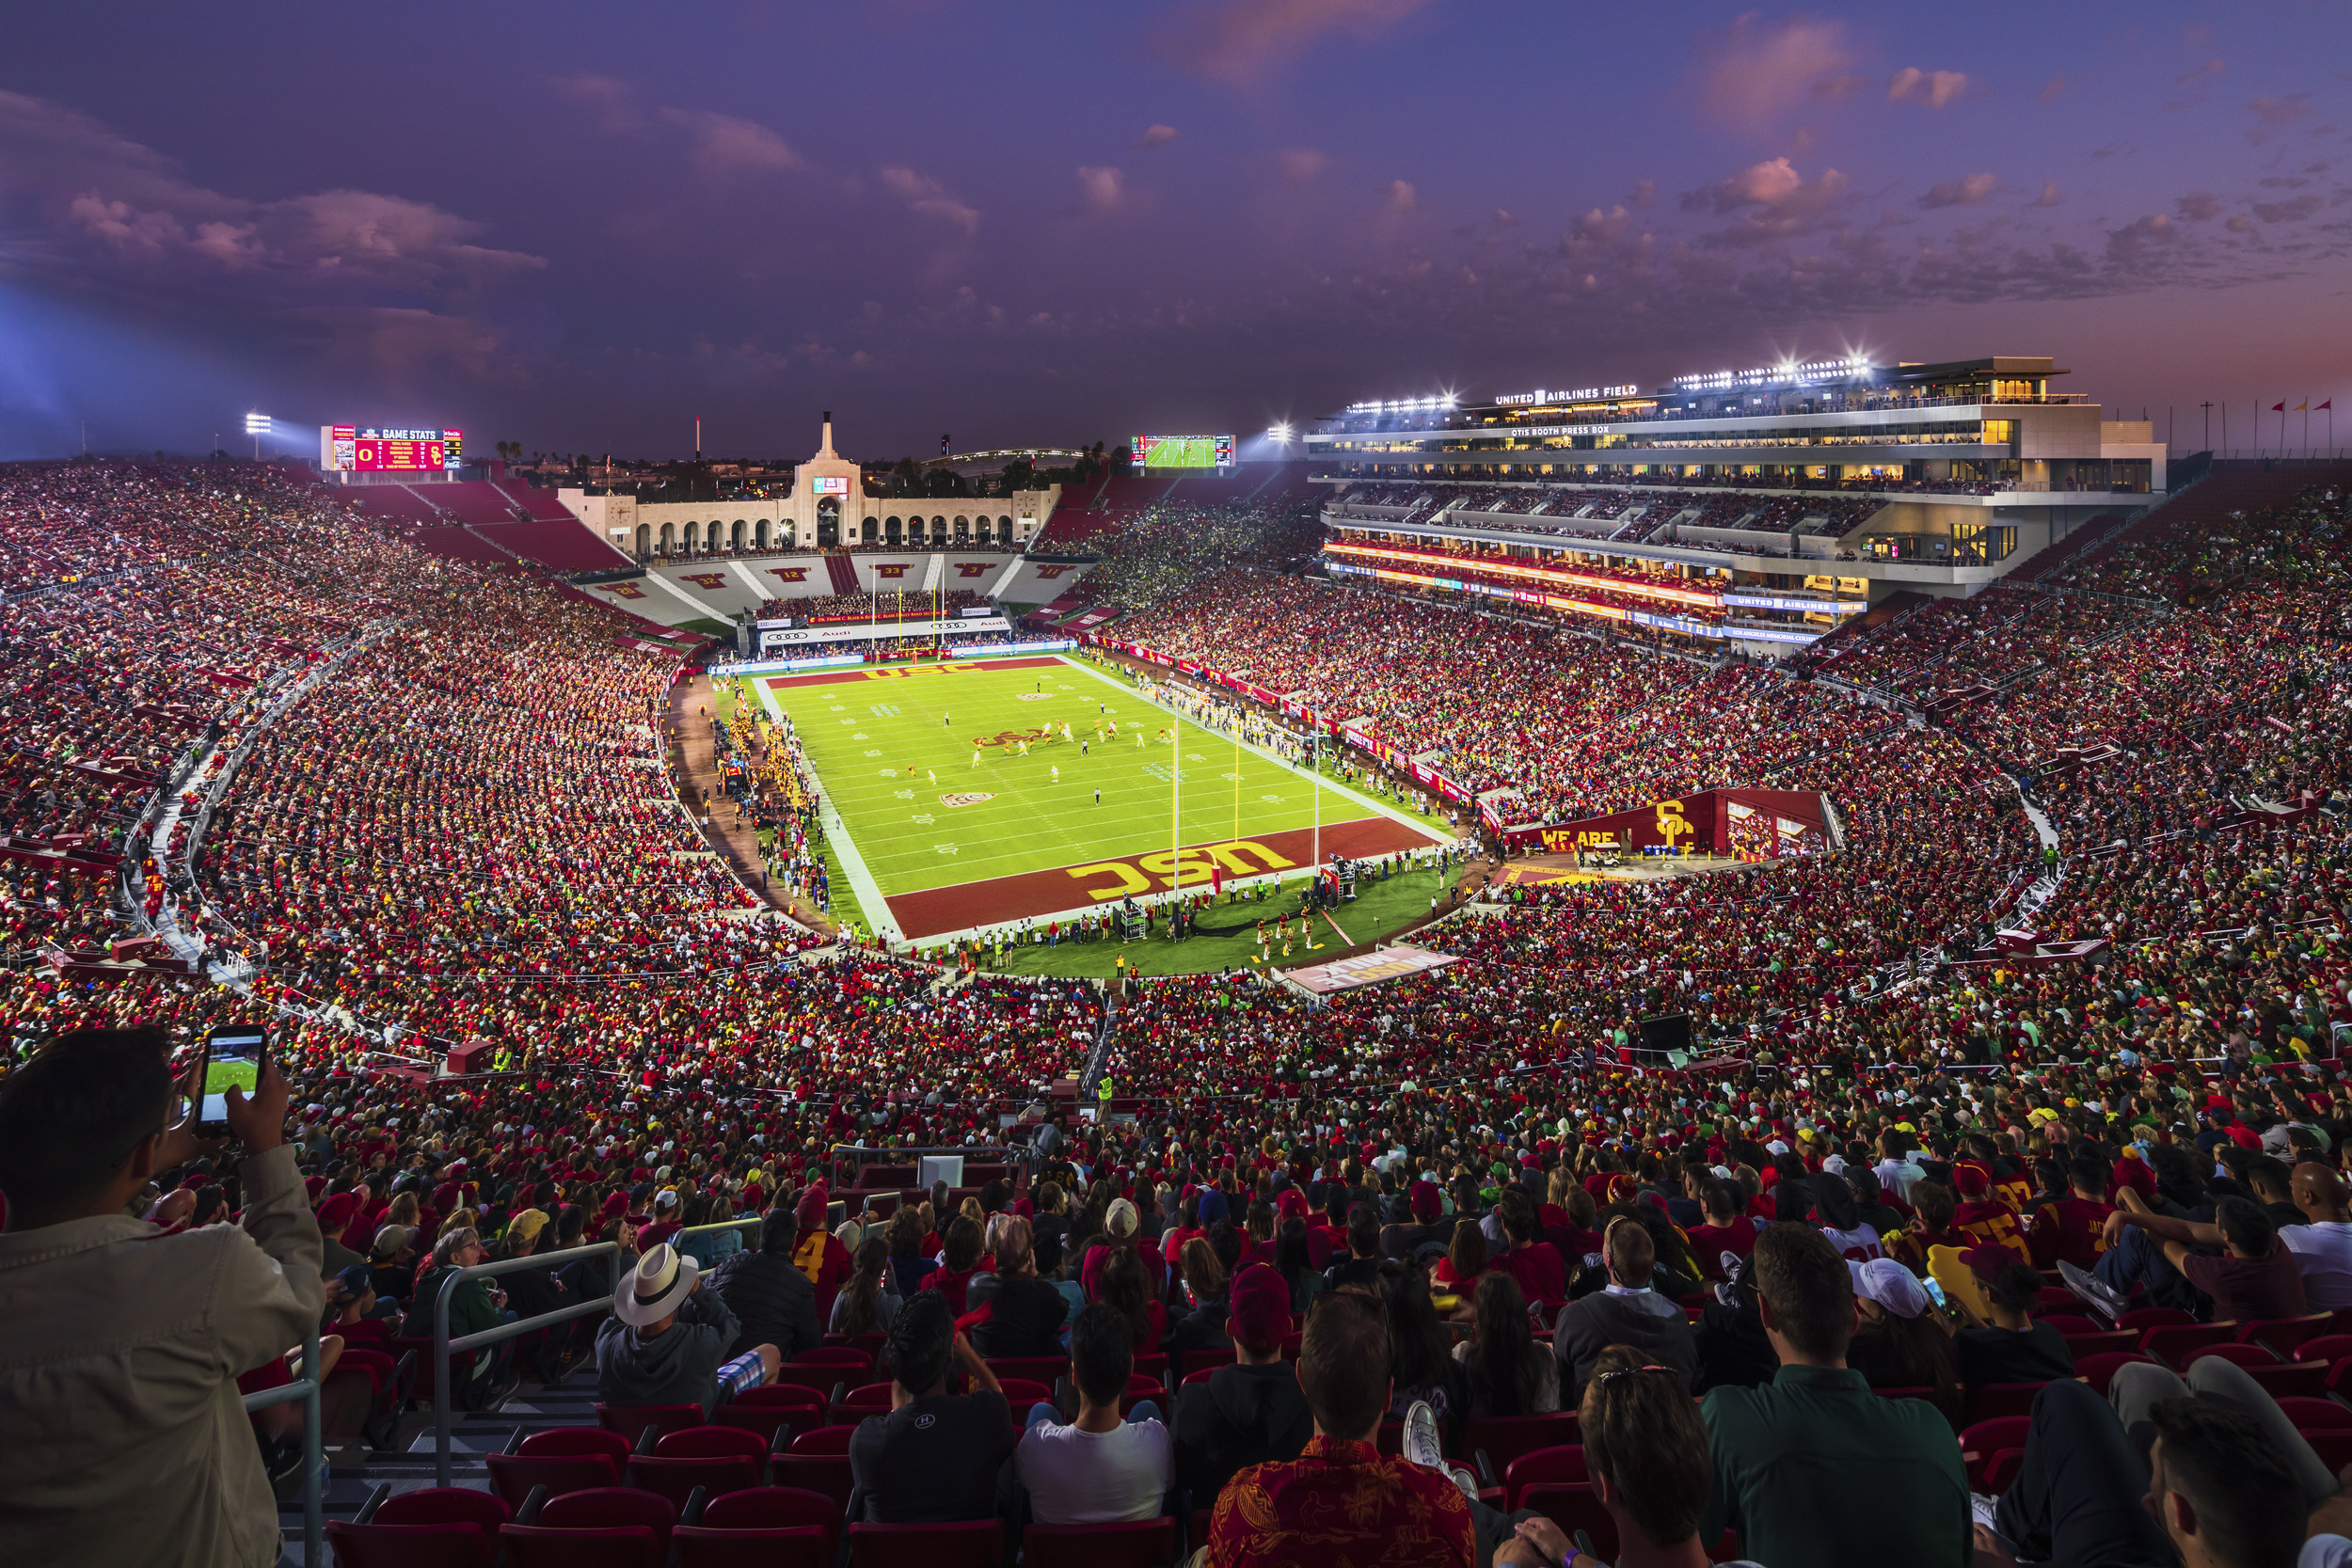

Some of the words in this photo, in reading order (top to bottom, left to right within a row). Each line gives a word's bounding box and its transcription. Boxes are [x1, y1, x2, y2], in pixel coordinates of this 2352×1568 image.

[1496, 394, 1534, 405] UNITED
[1547, 388, 1598, 402] AIRLINES
[1603, 385, 1638, 397] FIELD
[383, 429, 409, 439] GAME
[409, 430, 436, 440] STATS
[1562, 426, 1589, 435] PRESS
[1592, 425, 1610, 434] BOX
[358, 449, 373, 461] O
[616, 586, 636, 595] 20
[1784, 602, 1830, 610] AIRLINES
[862, 663, 983, 680] USC
[1541, 830, 1570, 846] WE
[1577, 832, 1614, 847] ARE
[1065, 841, 1297, 901] USC
[1310, 954, 1398, 976] MILK
[1313, 955, 1443, 988] MUSCLE
[794, 1231, 828, 1284] 4
